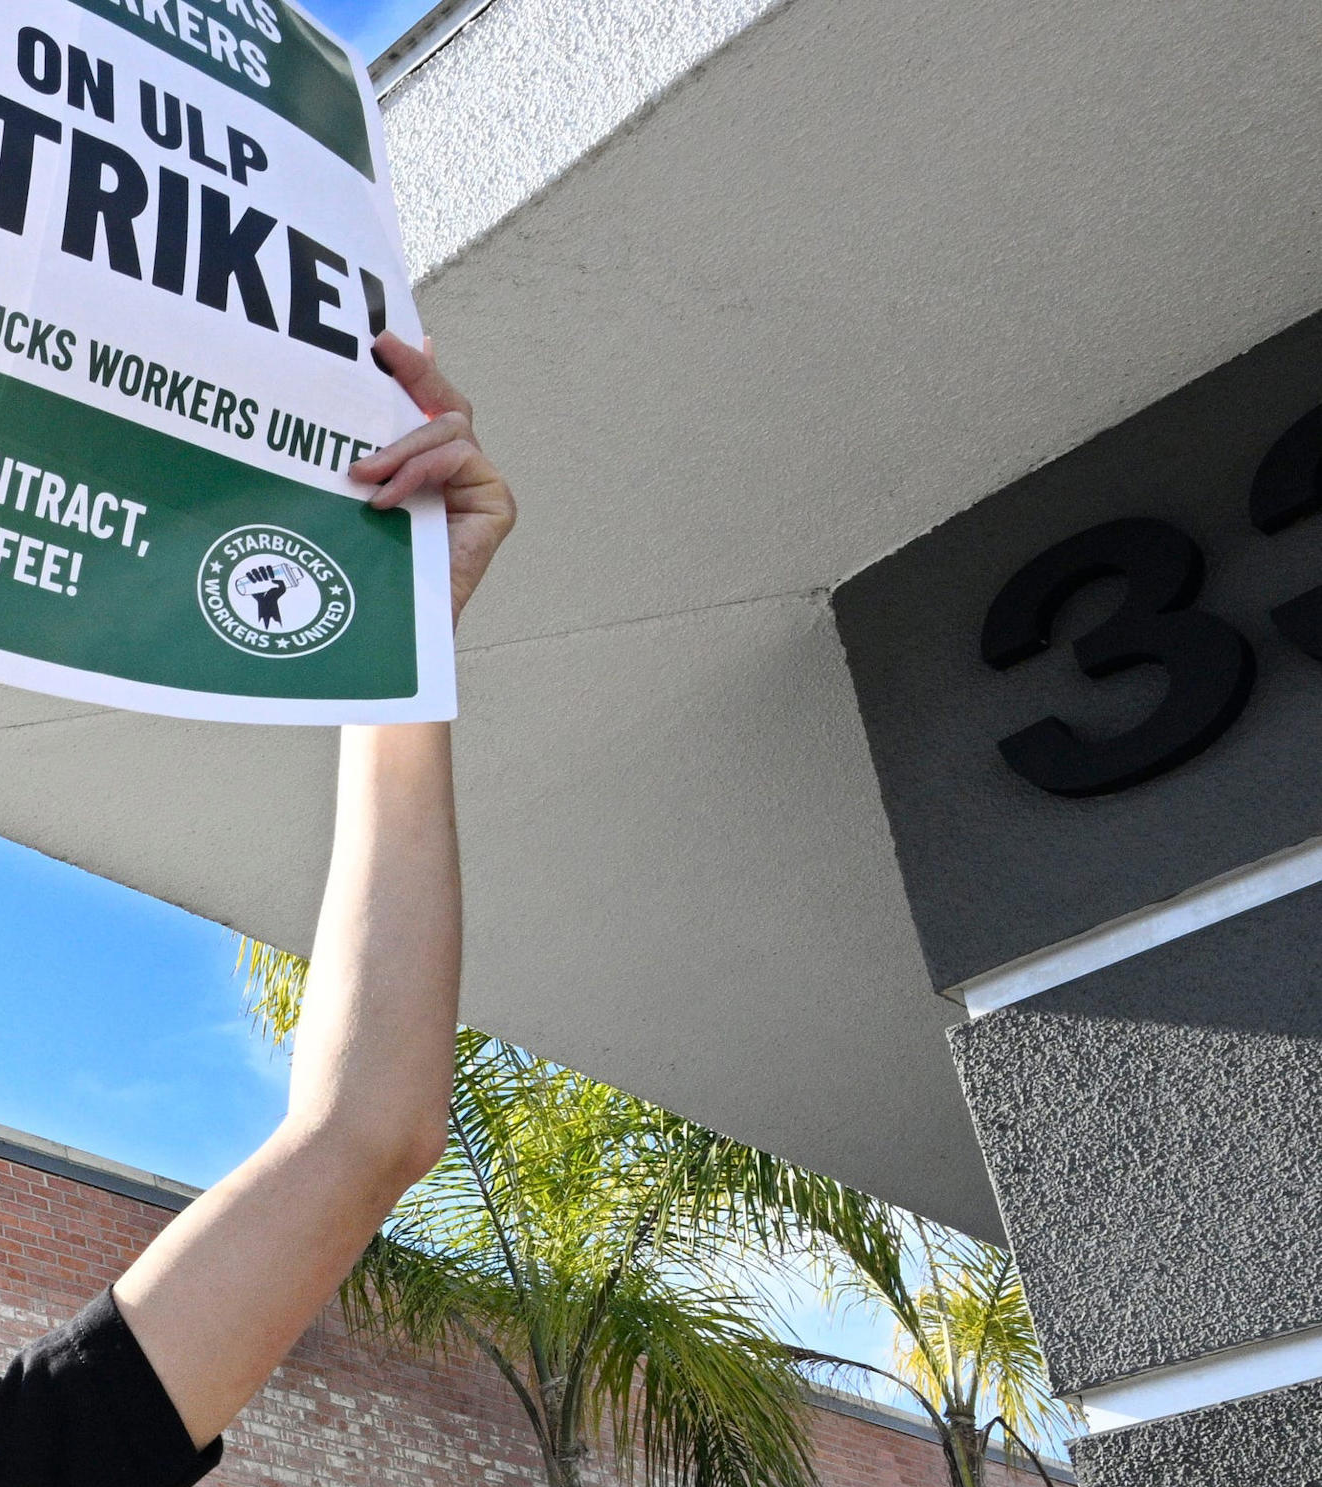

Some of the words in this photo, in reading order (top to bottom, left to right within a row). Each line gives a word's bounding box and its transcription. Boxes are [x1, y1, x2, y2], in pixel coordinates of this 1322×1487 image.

[111, 0, 271, 88] KERS
[17, 26, 115, 124] ON
[139, 79, 269, 187] ULP
[89, 339, 259, 440] WORKERS
[267, 408, 383, 476] UNITE
[223, 533, 334, 583] STARBUCKS
[204, 578, 270, 648] WORKERS
[291, 601, 345, 647] UNITED
